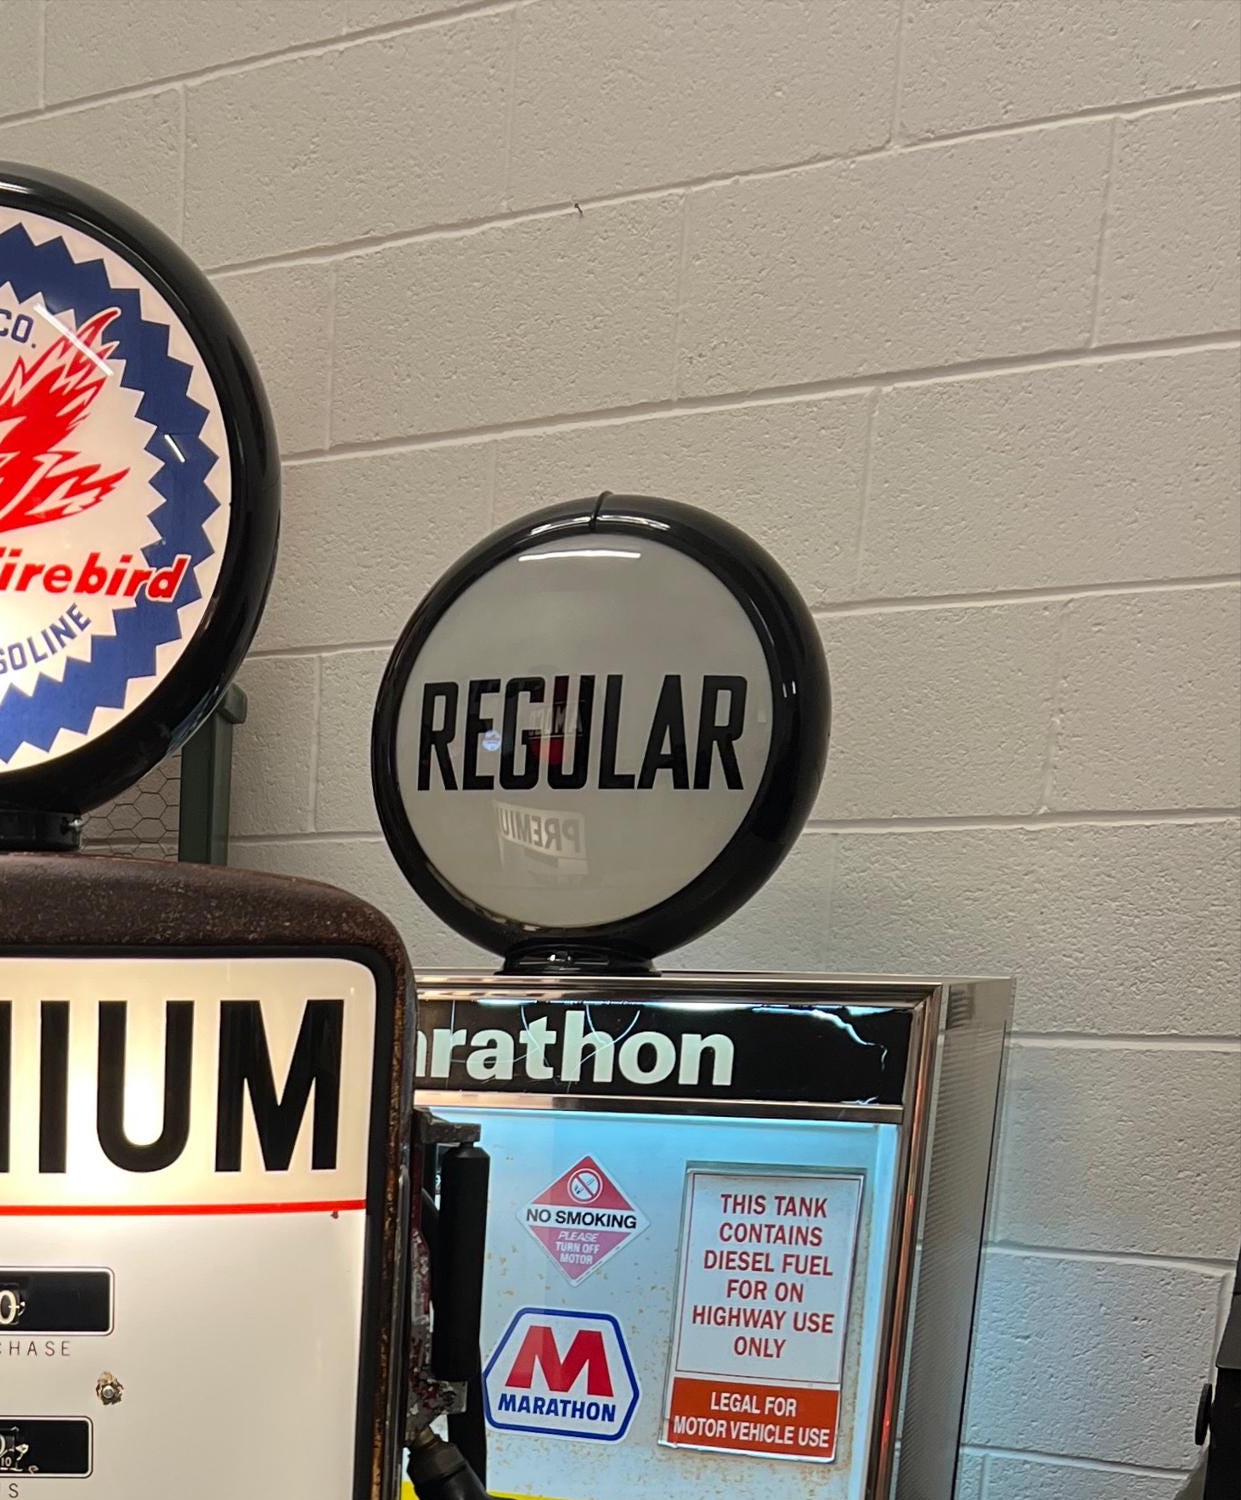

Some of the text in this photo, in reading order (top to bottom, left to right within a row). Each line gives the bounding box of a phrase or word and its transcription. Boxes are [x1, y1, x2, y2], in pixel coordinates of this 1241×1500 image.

[417, 673, 748, 792] REGULAR
[413, 1010, 735, 1087] rathon
[526, 1208, 637, 1229] NO SMOKING
[721, 1194, 828, 1218] THIS TANK
[555, 1241, 600, 1254] TURN OFF
[557, 1231, 599, 1242] PLEASE
[719, 1222, 823, 1247] CONTAINS
[559, 1254, 593, 1265] MOTOR
[703, 1249, 834, 1277] DIESEL FUEL
[726, 1279, 804, 1303] FOR ON
[692, 1304, 835, 1334] HIGHWAY USE
[733, 1336, 786, 1359] ONLY
[505, 1324, 614, 1398] M
[497, 1393, 616, 1423] MARATHON
[710, 1391, 797, 1418] LEGAL FOR
[673, 1416, 830, 1449] MOTOR VEHICLE USE
